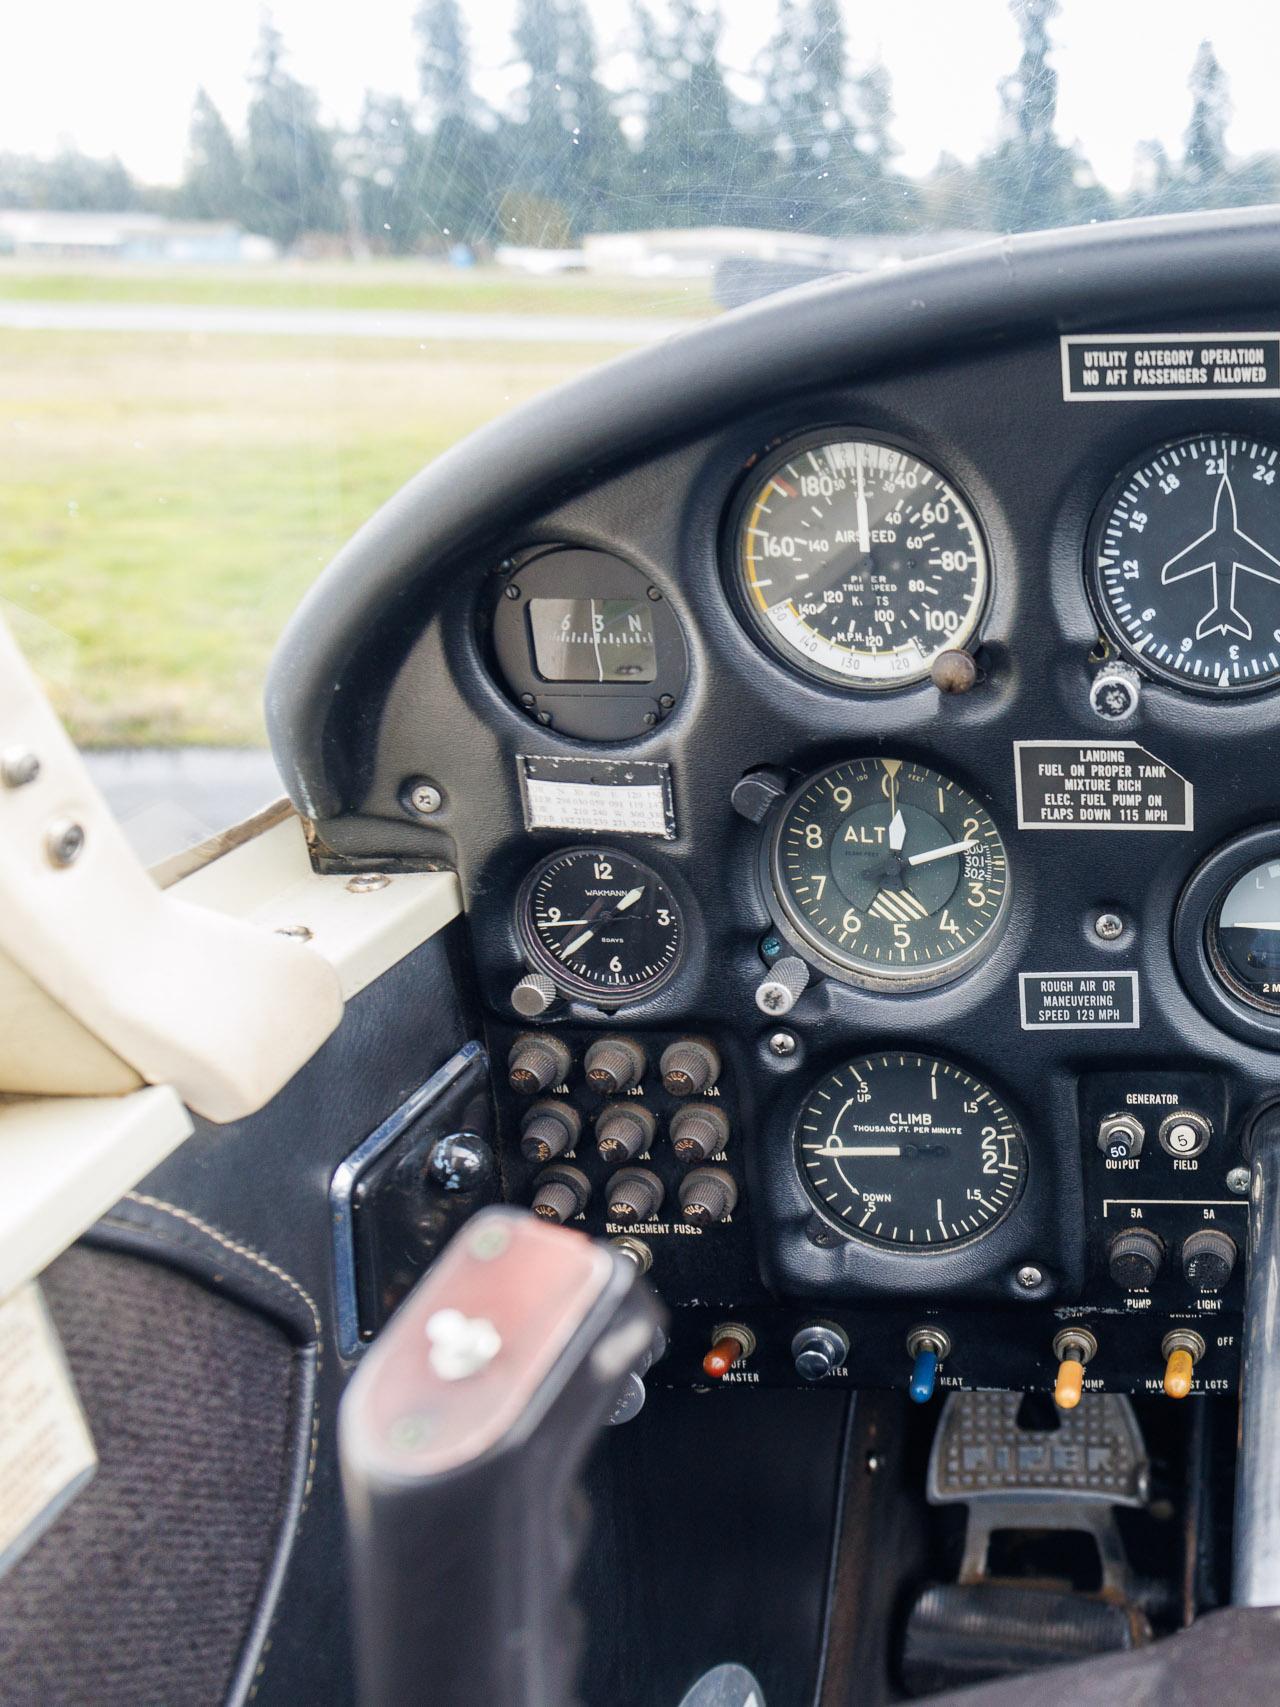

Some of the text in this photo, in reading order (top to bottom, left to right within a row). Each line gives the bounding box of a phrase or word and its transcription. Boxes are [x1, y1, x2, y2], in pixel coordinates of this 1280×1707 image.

[1083, 348, 1265, 367] UTILITY CATEGORY OPERATION
[1082, 367, 1267, 386] NO AFT PASSENGERS ALLOWED
[1252, 465, 1276, 486] 24
[801, 476, 833, 497] 180
[763, 536, 795, 557] 160
[941, 551, 968, 572] 80
[1122, 559, 1140, 580] 12
[627, 615, 643, 632] N
[925, 611, 958, 630] 100
[1079, 750, 1125, 763] LANDING
[1038, 764, 1167, 778] FUEL ON PROPER TANK
[1064, 779, 1142, 792] MIXTURE RICH
[1044, 793, 1162, 807] ELEC. FUEL PUMP ON
[1041, 808, 1168, 822] FLAPS DOWN 115 MPH
[843, 826, 885, 843] ALT
[594, 862, 614, 880] 12
[584, 889, 628, 897] WAKMANN
[1040, 980, 1116, 992] ROUGH AIR OR
[1262, 983, 1270, 993] 2
[1043, 995, 1113, 1007] MANEUVERING
[1038, 1009, 1120, 1021] SPEED 129 MPH
[857, 1094, 872, 1103] UP
[1126, 1093, 1179, 1105] GENERATOR
[889, 1113, 932, 1125] CLIMB
[853, 1125, 963, 1135] THOUSAND FT. PER MINUTE
[1177, 1134, 1188, 1147] 5
[1110, 1145, 1127, 1158] 50
[1173, 1159, 1198, 1170] FIELD
[862, 1193, 892, 1202] DOWN
[1130, 1207, 1143, 1218] 5A
[1203, 1208, 1216, 1219] 5A
[605, 1223, 702, 1235] REPLACEMENT FUSES
[1196, 1300, 1221, 1310] LIGHT
[1217, 1336, 1234, 1346] OFF
[722, 1372, 760, 1383] MASTER
[1205, 1379, 1229, 1389] LGTS
